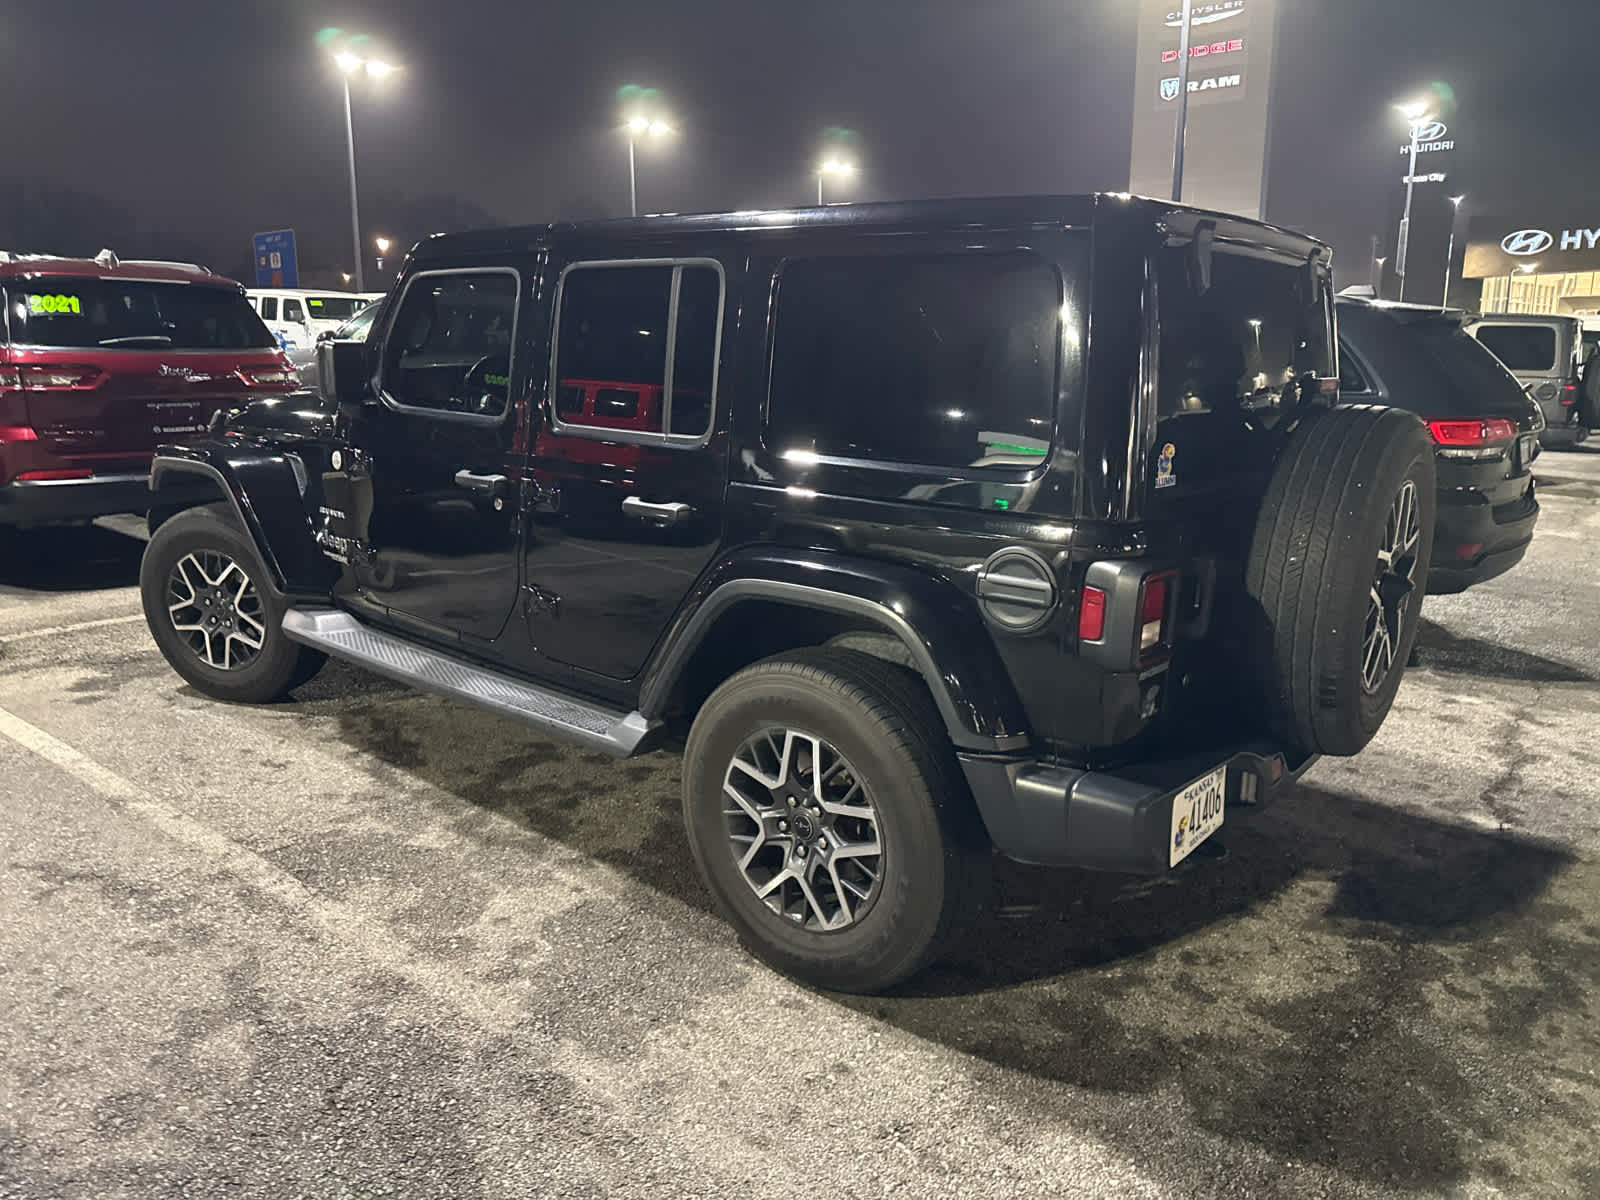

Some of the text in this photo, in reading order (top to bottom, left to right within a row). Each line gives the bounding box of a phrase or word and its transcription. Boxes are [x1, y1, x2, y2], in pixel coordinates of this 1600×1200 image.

[1186, 74, 1241, 93] RAM
[1560, 228, 1600, 250] HY
[29, 294, 80, 314] 2021
[320, 529, 347, 554] Jeep
[1189, 783, 1221, 834] 41406
